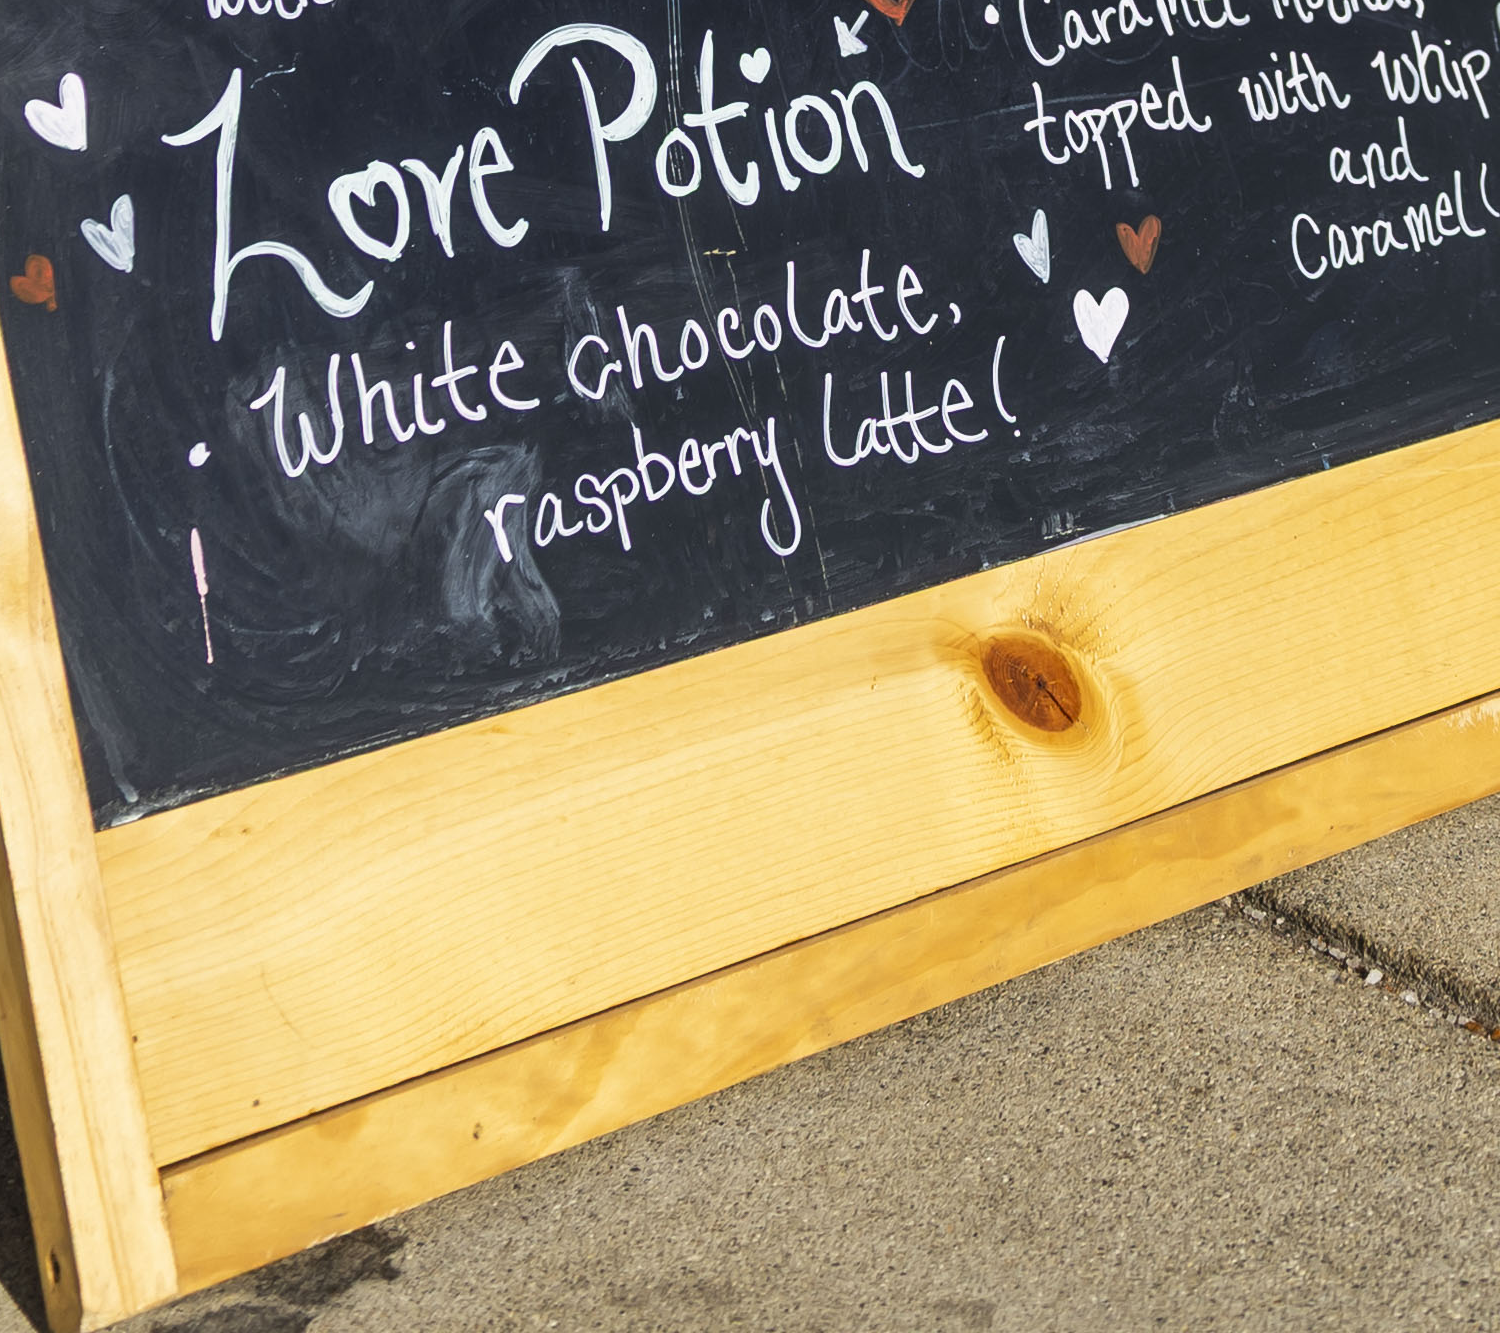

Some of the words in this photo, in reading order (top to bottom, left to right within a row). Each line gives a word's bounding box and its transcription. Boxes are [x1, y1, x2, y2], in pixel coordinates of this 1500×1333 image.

[161, 68, 527, 339] Love
[509, 23, 924, 231] Potion
[1024, 58, 1211, 189] topped
[1239, 52, 1352, 125] with
[1373, 30, 1492, 117] whip
[1331, 119, 1430, 184] and
[249, 319, 539, 477] White
[567, 248, 960, 401] chocolate,
[483, 414, 802, 562] raspberry
[822, 335, 1020, 467] latte!
